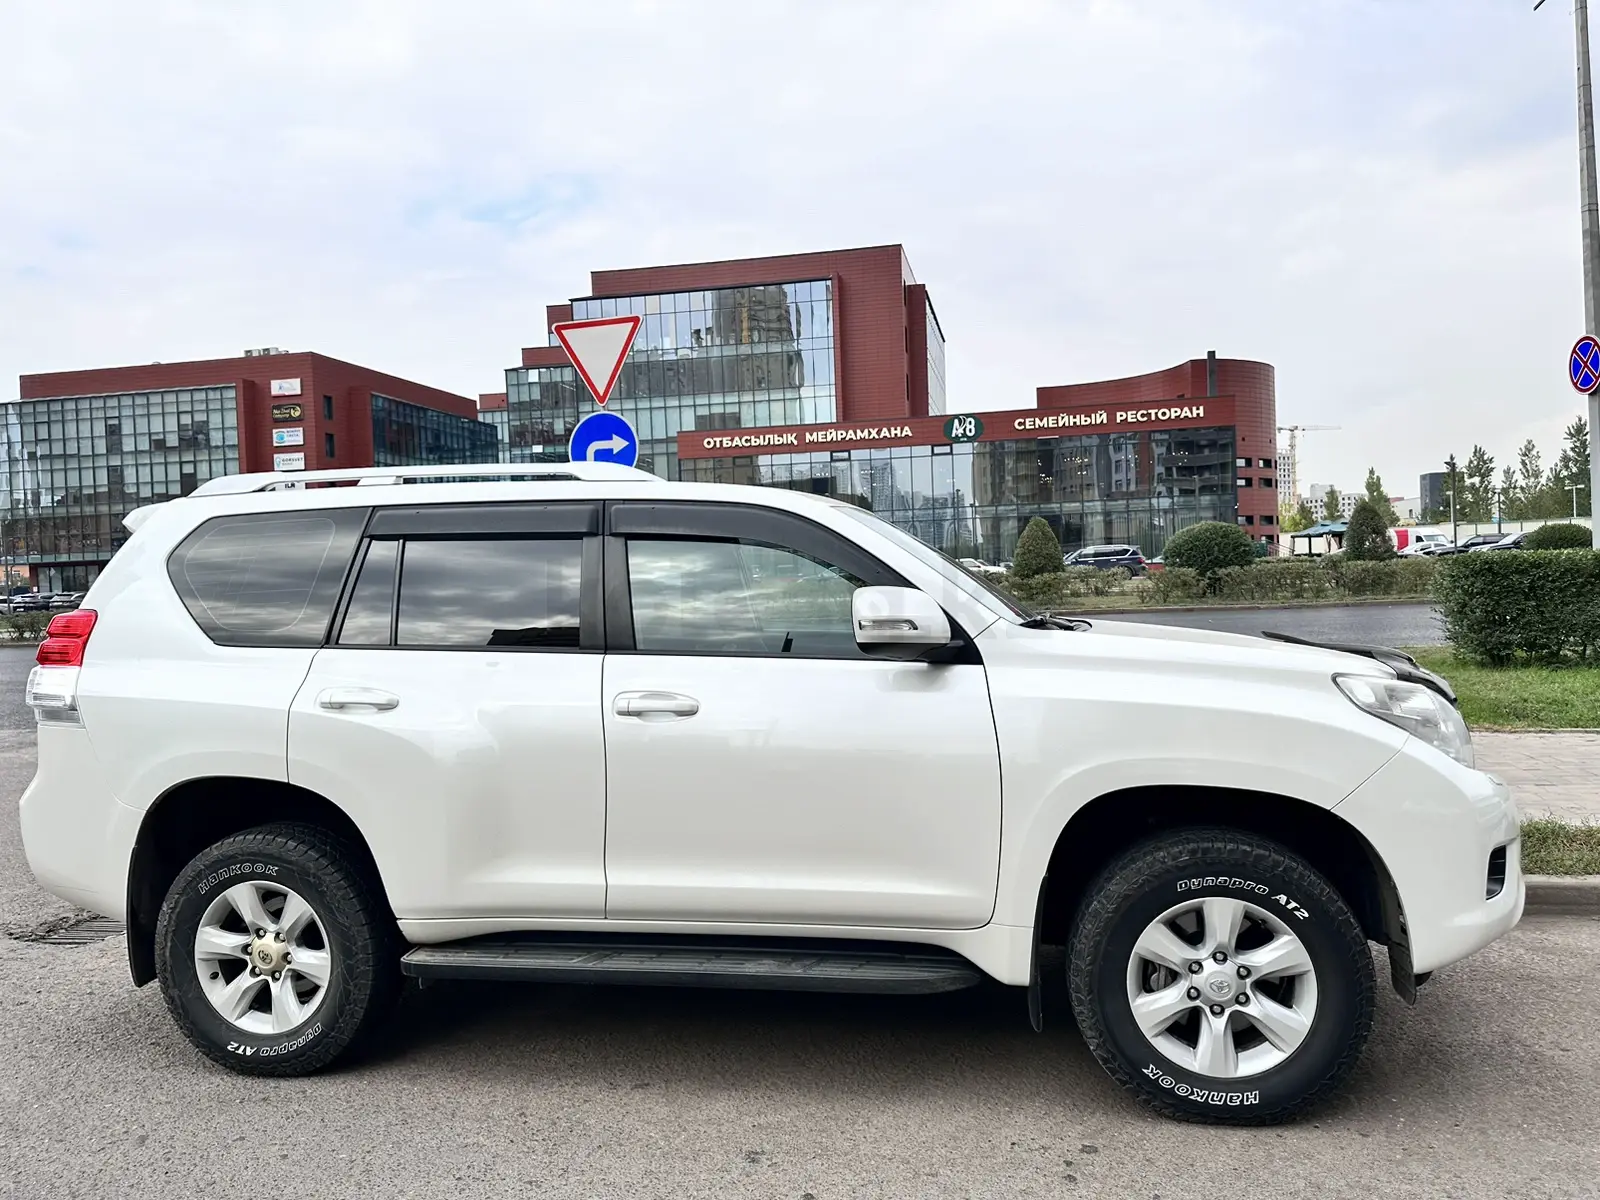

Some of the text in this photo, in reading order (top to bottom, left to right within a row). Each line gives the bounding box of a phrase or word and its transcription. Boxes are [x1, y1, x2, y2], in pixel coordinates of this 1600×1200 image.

[1014, 406, 1205, 430] СЕМЕЙНЫЙ РЕСТОРАН
[703, 426, 912, 449] ОТБАСЫЛЫҚ МЕЙРАМХАНА
[1271, 893, 1310, 920] AT2
[226, 1040, 257, 1057] AT2
